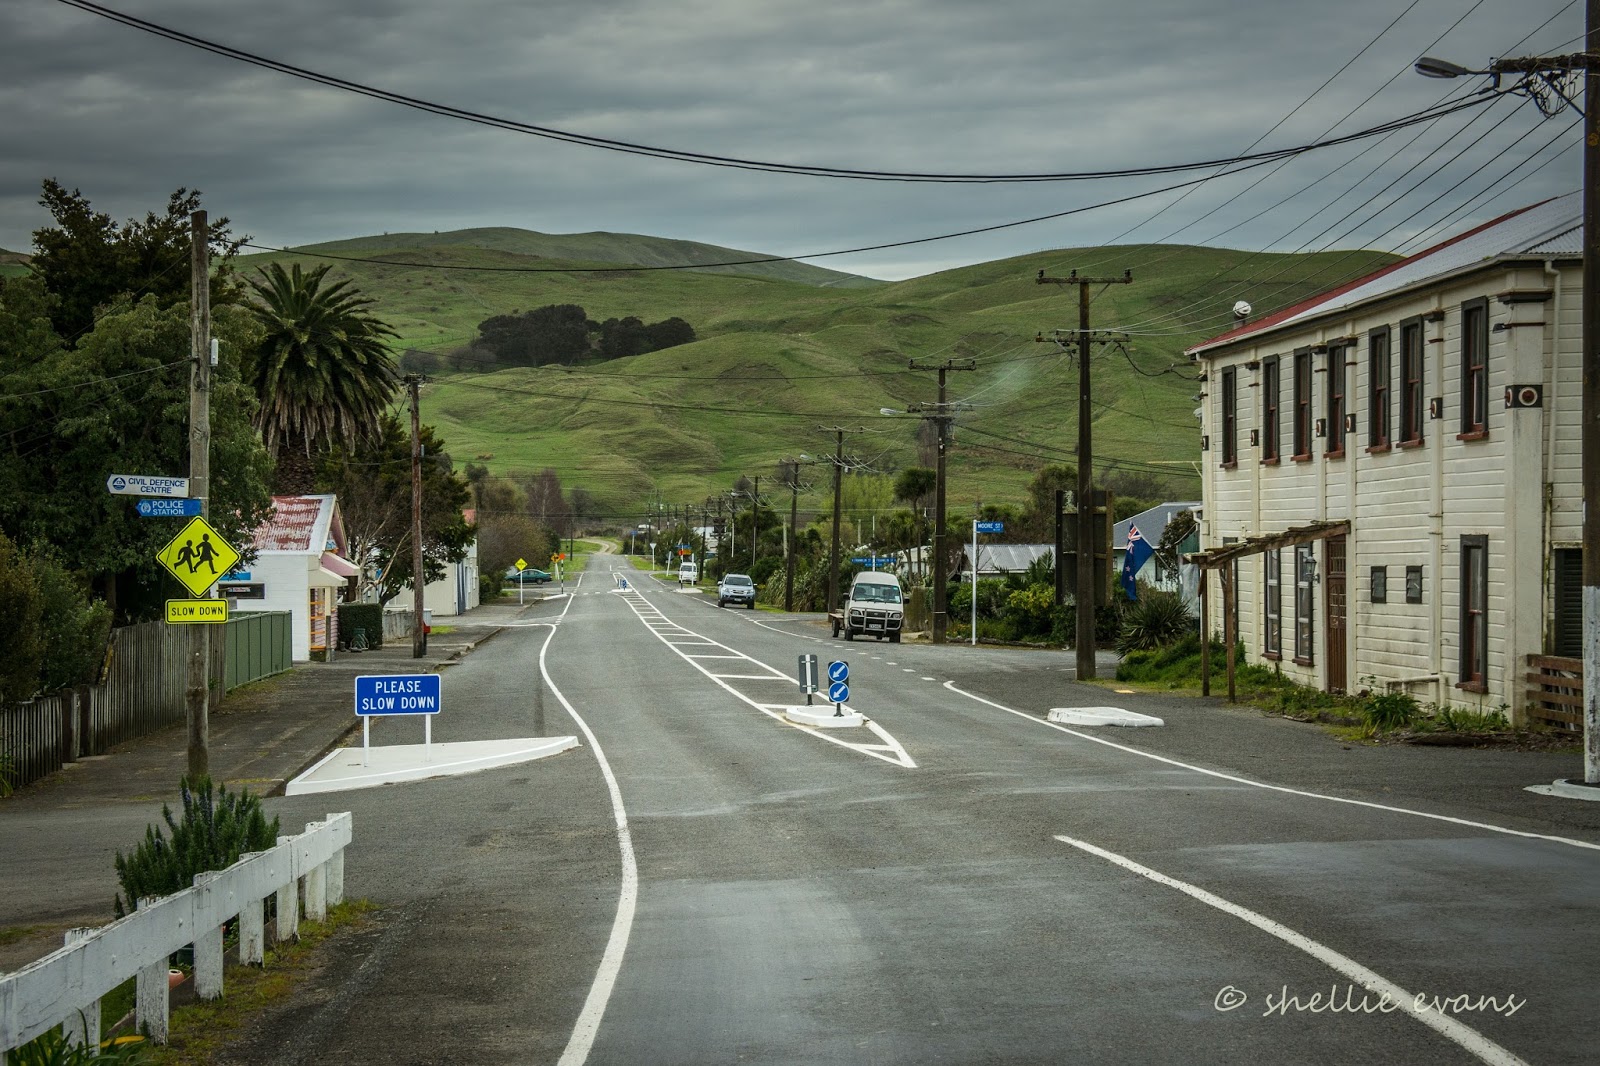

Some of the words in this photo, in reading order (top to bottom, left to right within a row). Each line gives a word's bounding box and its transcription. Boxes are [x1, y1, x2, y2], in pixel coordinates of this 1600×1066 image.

[128, 477, 147, 486] CIVIL
[149, 478, 185, 487] DEFENCE
[140, 486, 172, 494] CENTRE
[152, 500, 184, 509] POLICE
[171, 607, 195, 616] SLOW
[199, 606, 223, 616] DOWN
[375, 681, 421, 694] PLEASE
[362, 698, 395, 710] SLOW
[401, 696, 435, 709] DOWN
